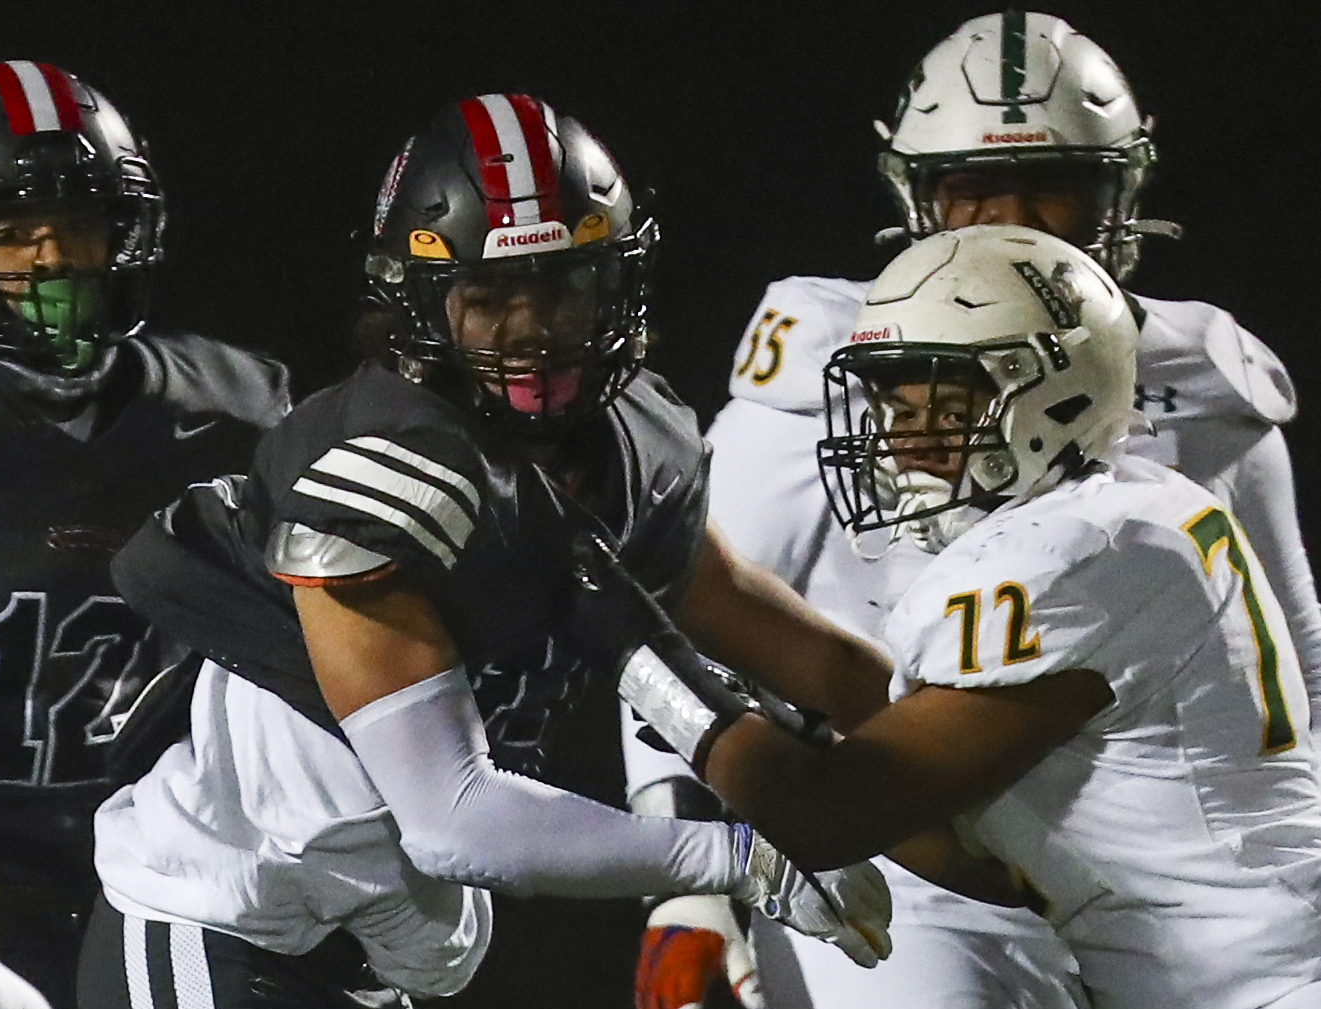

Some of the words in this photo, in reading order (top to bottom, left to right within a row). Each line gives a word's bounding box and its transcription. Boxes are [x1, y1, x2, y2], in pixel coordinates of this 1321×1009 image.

[496, 229, 564, 247] Riddell
[737, 309, 798, 386] 55
[944, 581, 1041, 675] 72
